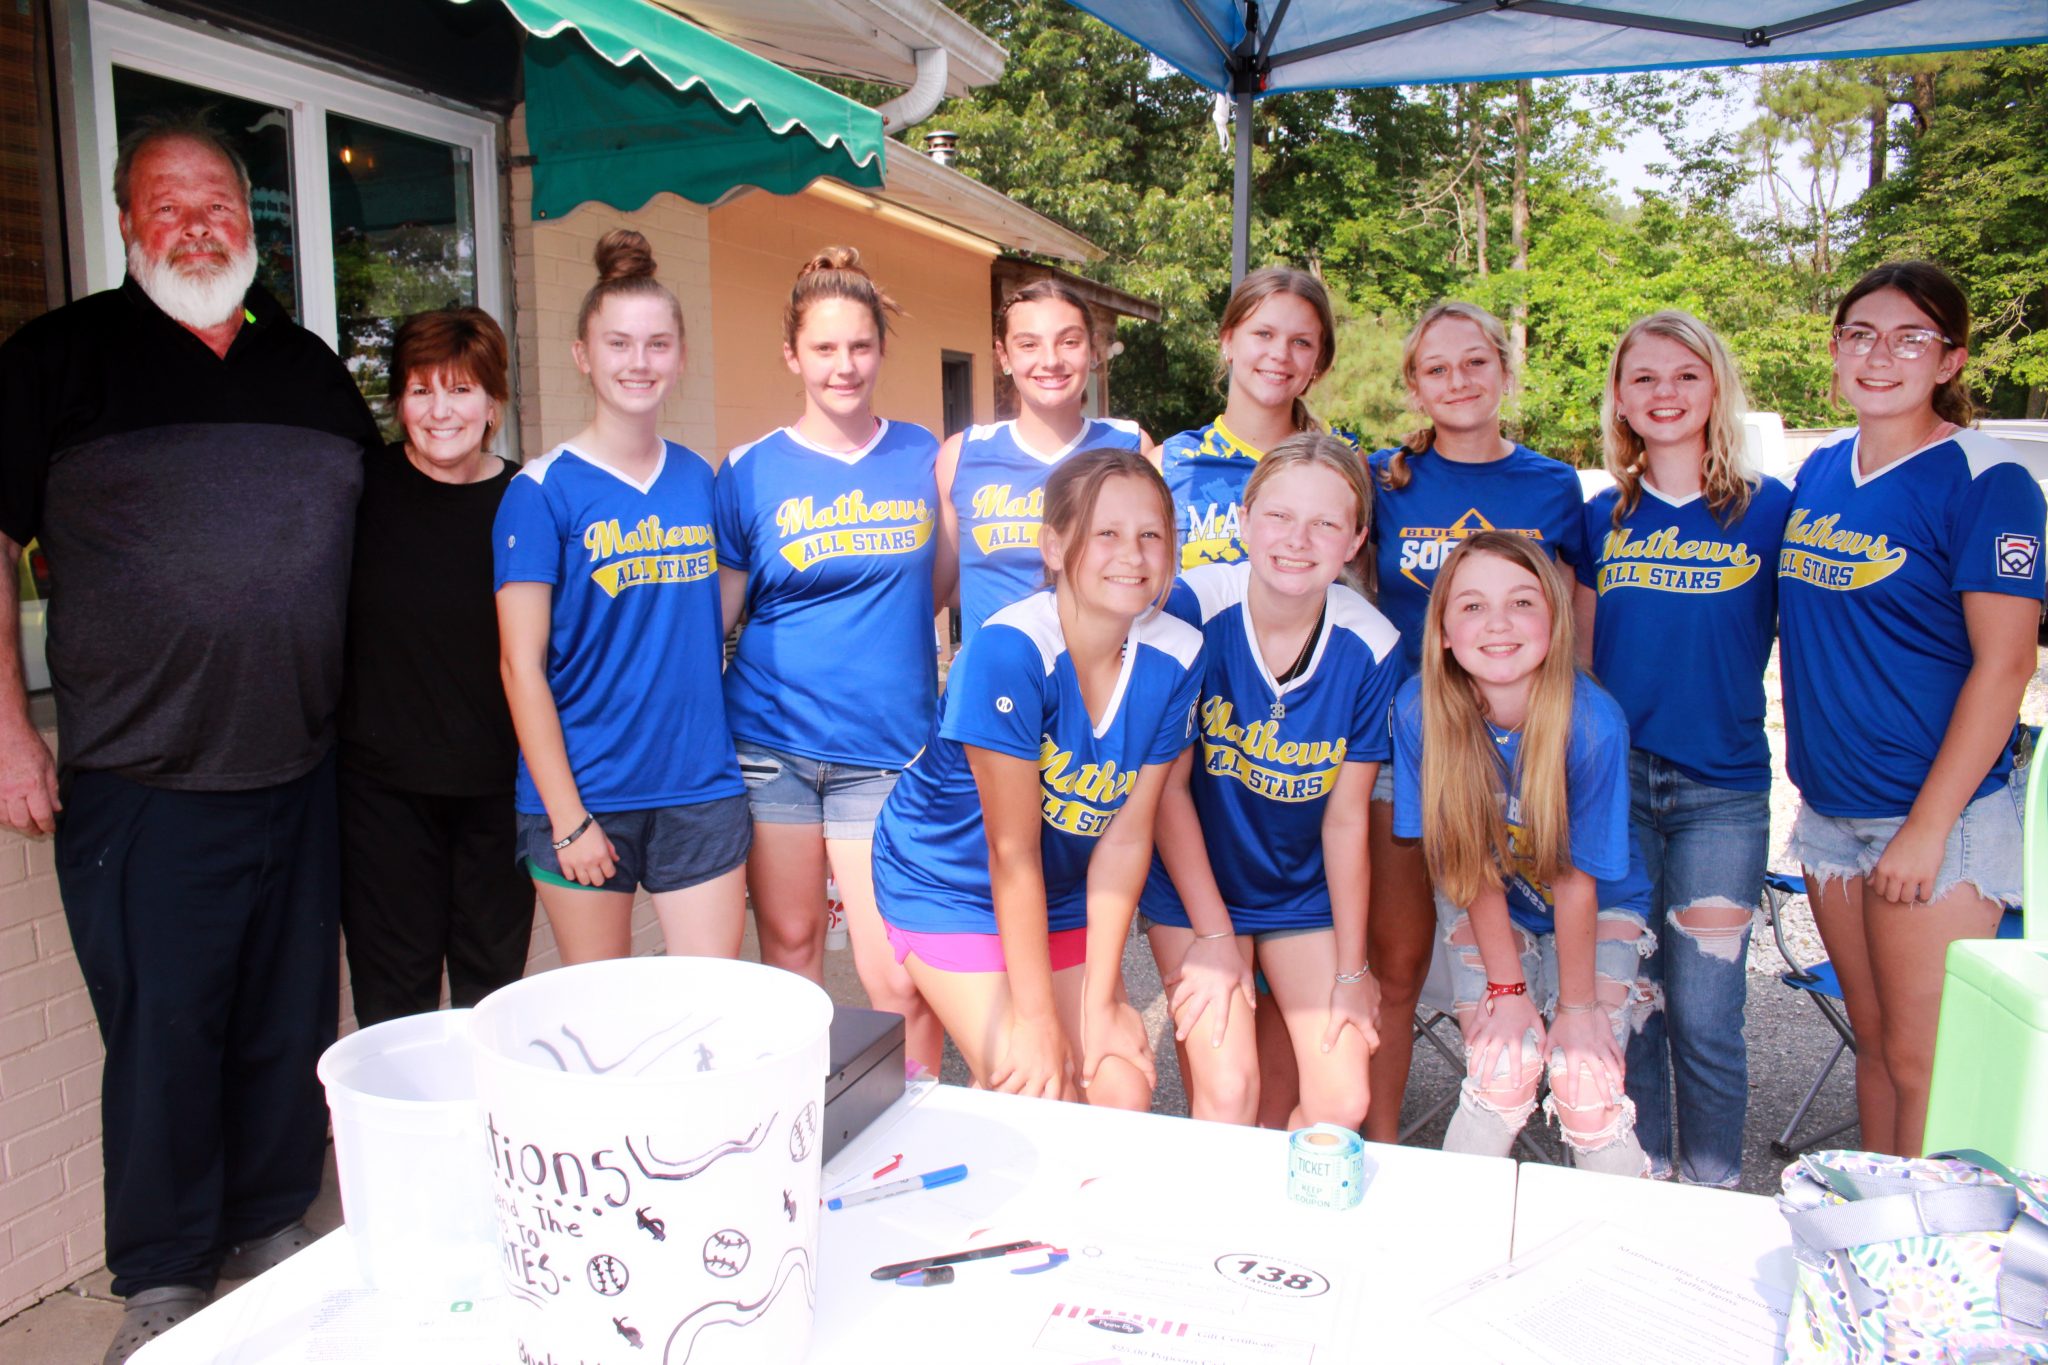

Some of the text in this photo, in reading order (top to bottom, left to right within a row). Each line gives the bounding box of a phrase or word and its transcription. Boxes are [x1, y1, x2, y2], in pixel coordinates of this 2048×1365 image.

[776, 489, 928, 538] Mathews
[972, 484, 1045, 518] Mat
[988, 526, 1031, 546] ALL
[1187, 502, 1241, 542] MA
[1405, 528, 1455, 537] BLUE
[803, 529, 916, 562] ALL STARS
[1400, 540, 1458, 571] SOF
[1595, 526, 1748, 567] Mathews
[616, 555, 709, 588] ALL STARS
[1604, 566, 1722, 589] ALL STARS
[1779, 552, 1854, 586] LL STARS
[1201, 695, 1347, 767] Mathews
[1207, 750, 1323, 799] ALL STARS
[1041, 795, 1115, 833] LL ST
[1298, 1157, 1331, 1177] TICKET
[1295, 1194, 1331, 1208] COUPON
[1301, 1184, 1323, 1195] KEEP
[532, 1205, 583, 1238] The
[1237, 1260, 1314, 1290] 138
[1617, 1244, 1665, 1268] Mathews
[1666, 1263, 1694, 1278] Little
[1694, 1275, 1734, 1296] League
[1736, 1292, 1773, 1312] Senior
[1707, 1289, 1739, 1308] Items
